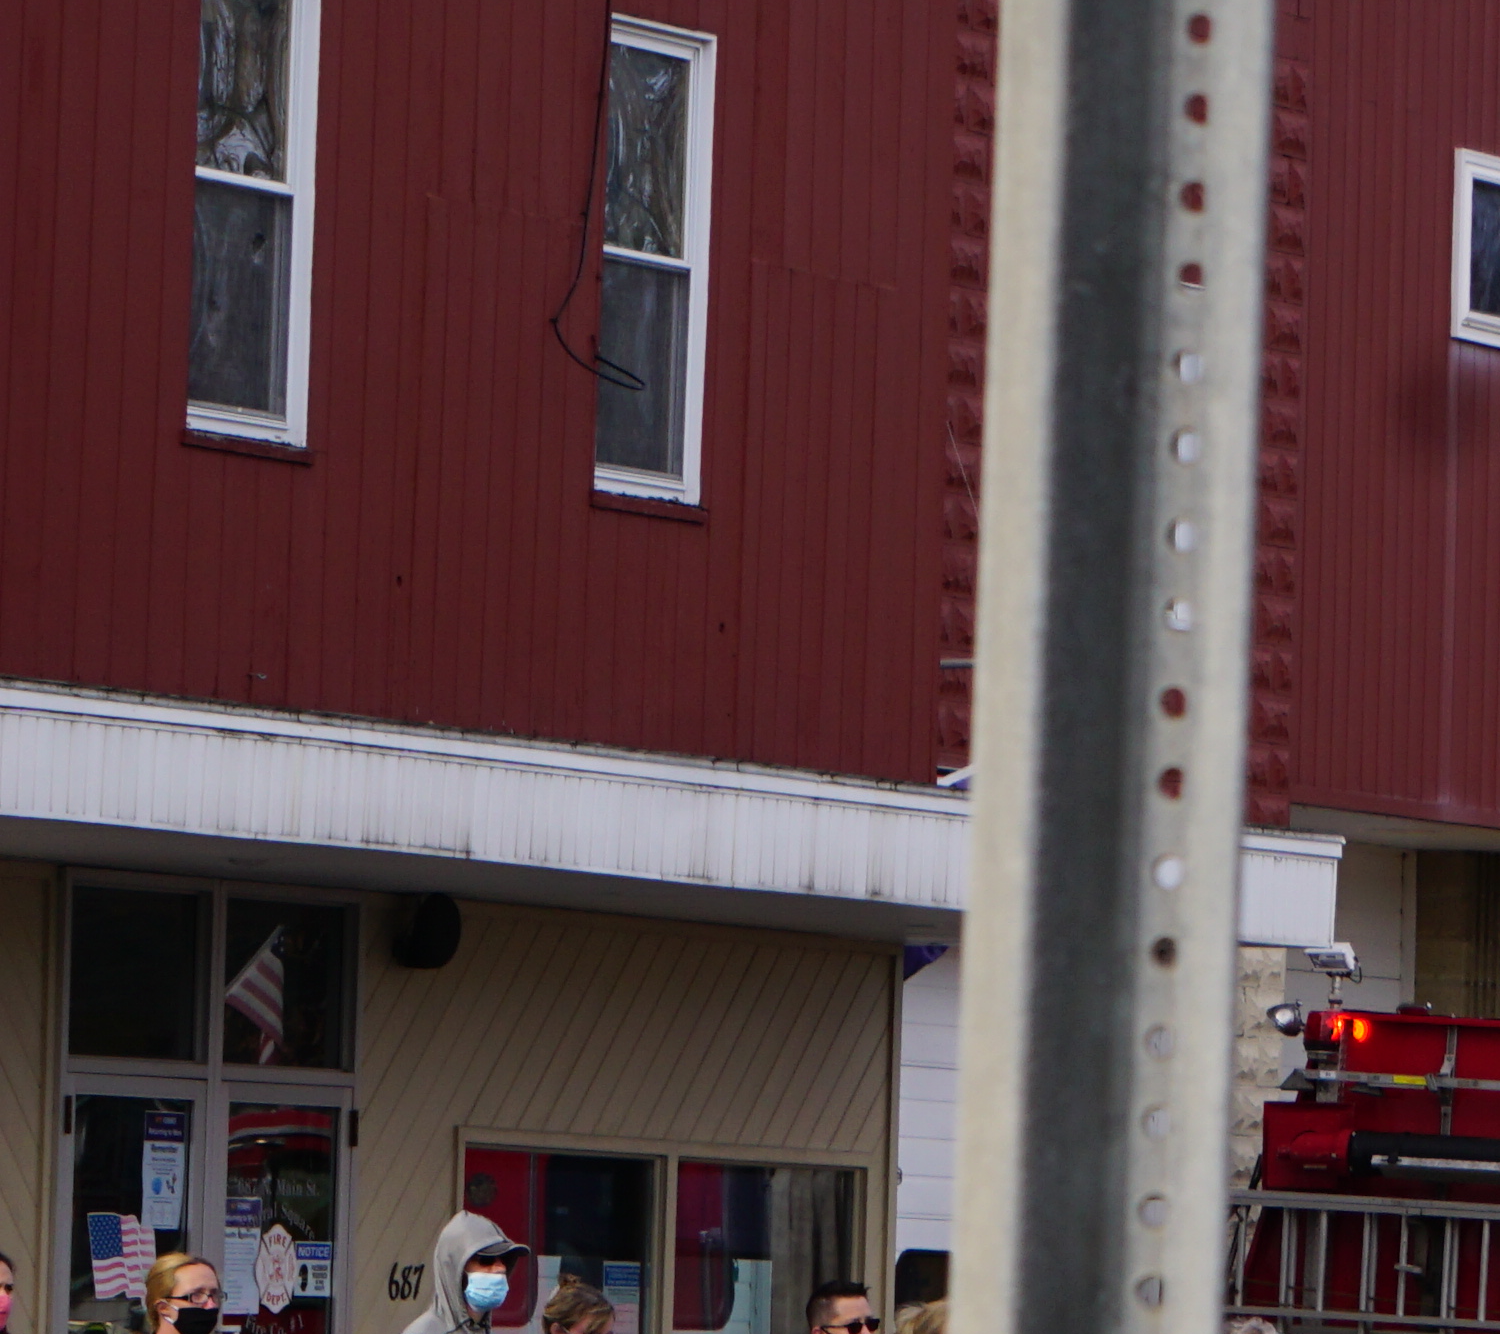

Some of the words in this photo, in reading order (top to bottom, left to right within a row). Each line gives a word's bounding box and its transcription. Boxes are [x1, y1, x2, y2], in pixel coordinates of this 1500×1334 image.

[268, 1233, 287, 1248] FIRE
[297, 1246, 330, 1258] NOTICE
[388, 1262, 425, 1301] 687
